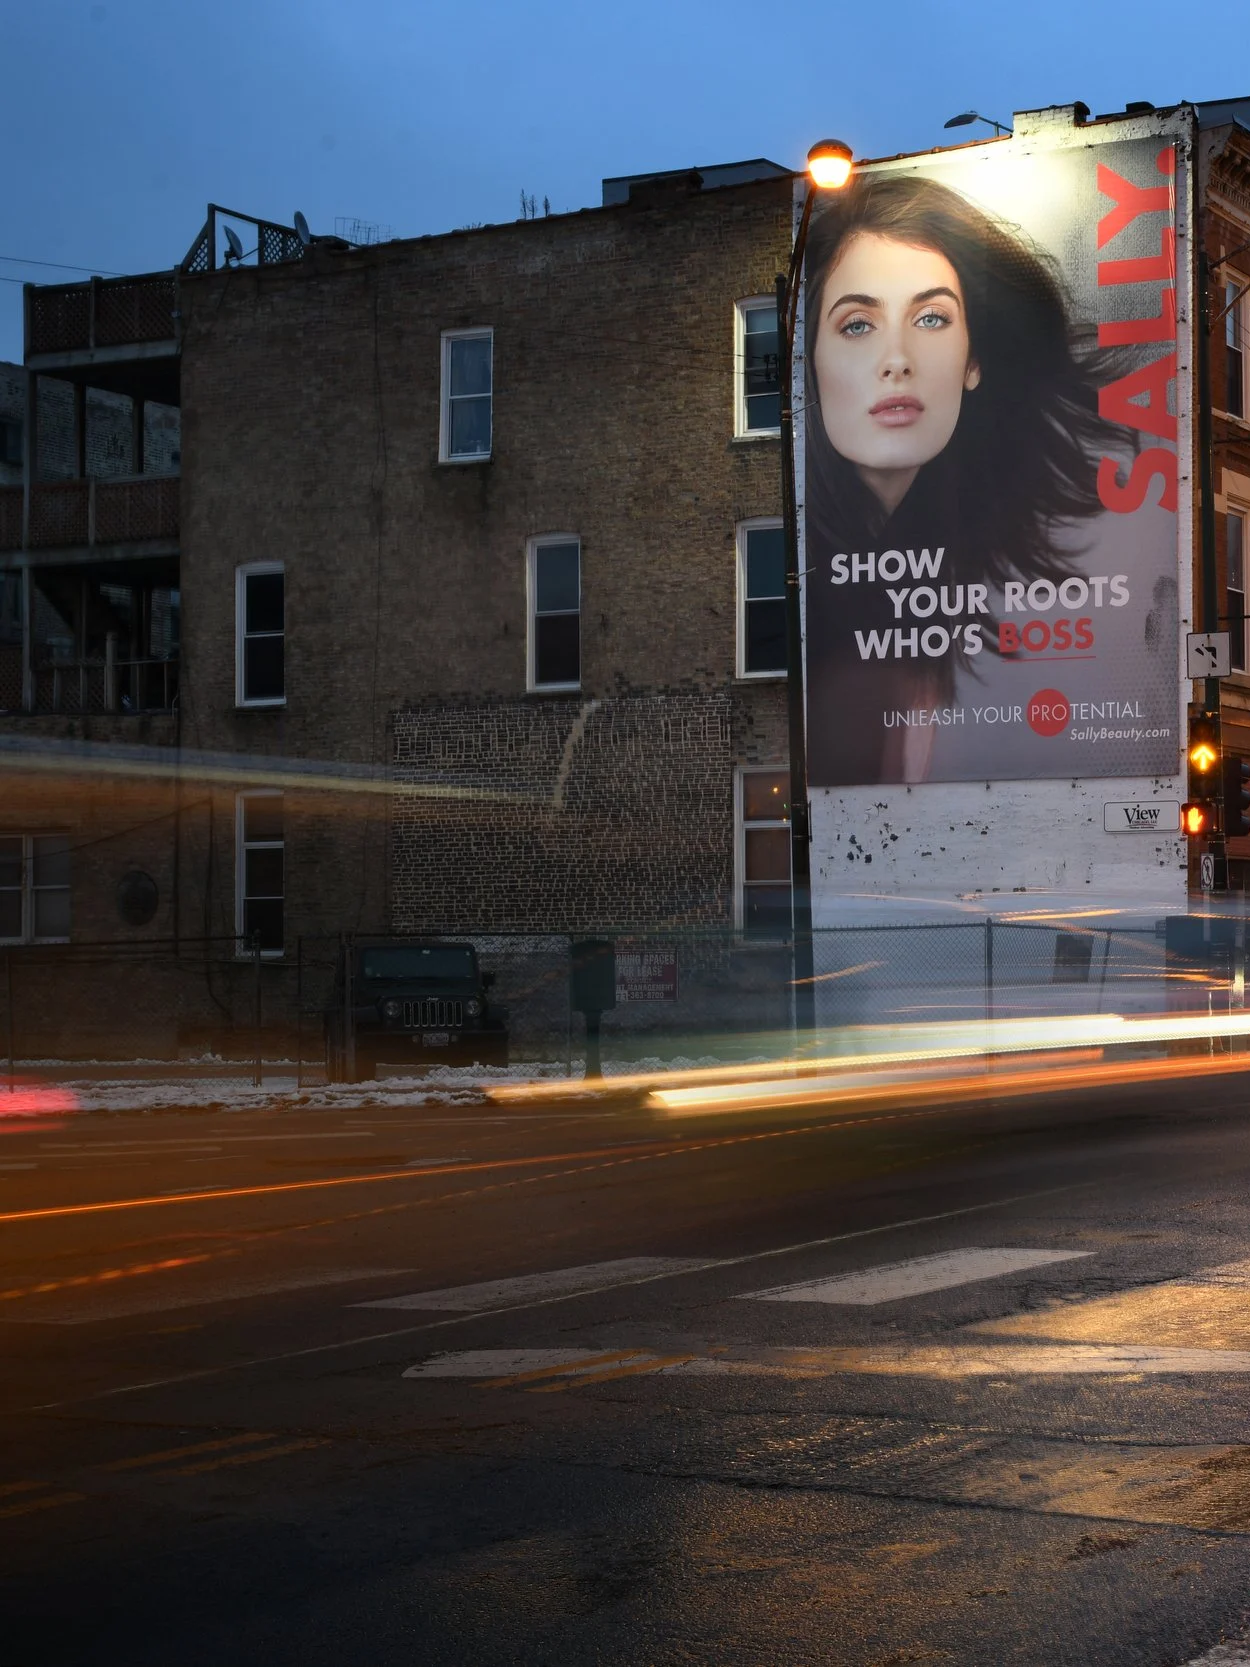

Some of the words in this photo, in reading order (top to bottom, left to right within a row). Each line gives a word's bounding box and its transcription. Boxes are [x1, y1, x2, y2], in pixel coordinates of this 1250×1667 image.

[830, 547, 945, 585] SHOW
[885, 584, 990, 619] YOUR
[1004, 575, 1130, 613] ROOTS
[854, 623, 983, 660] WHO'S
[998, 617, 1094, 654] BOSS
[883, 708, 965, 728] UNLEASH
[972, 706, 1023, 724] YOUR
[1069, 726, 1171, 744] SallyBeauty.com
[1123, 804, 1161, 825] View
[615, 953, 641, 966] RKING
[643, 953, 675, 965] SPACES
[618, 966, 634, 977] FOR
[637, 966, 663, 977] LEASE
[627, 983, 674, 992] MANAGEMENT
